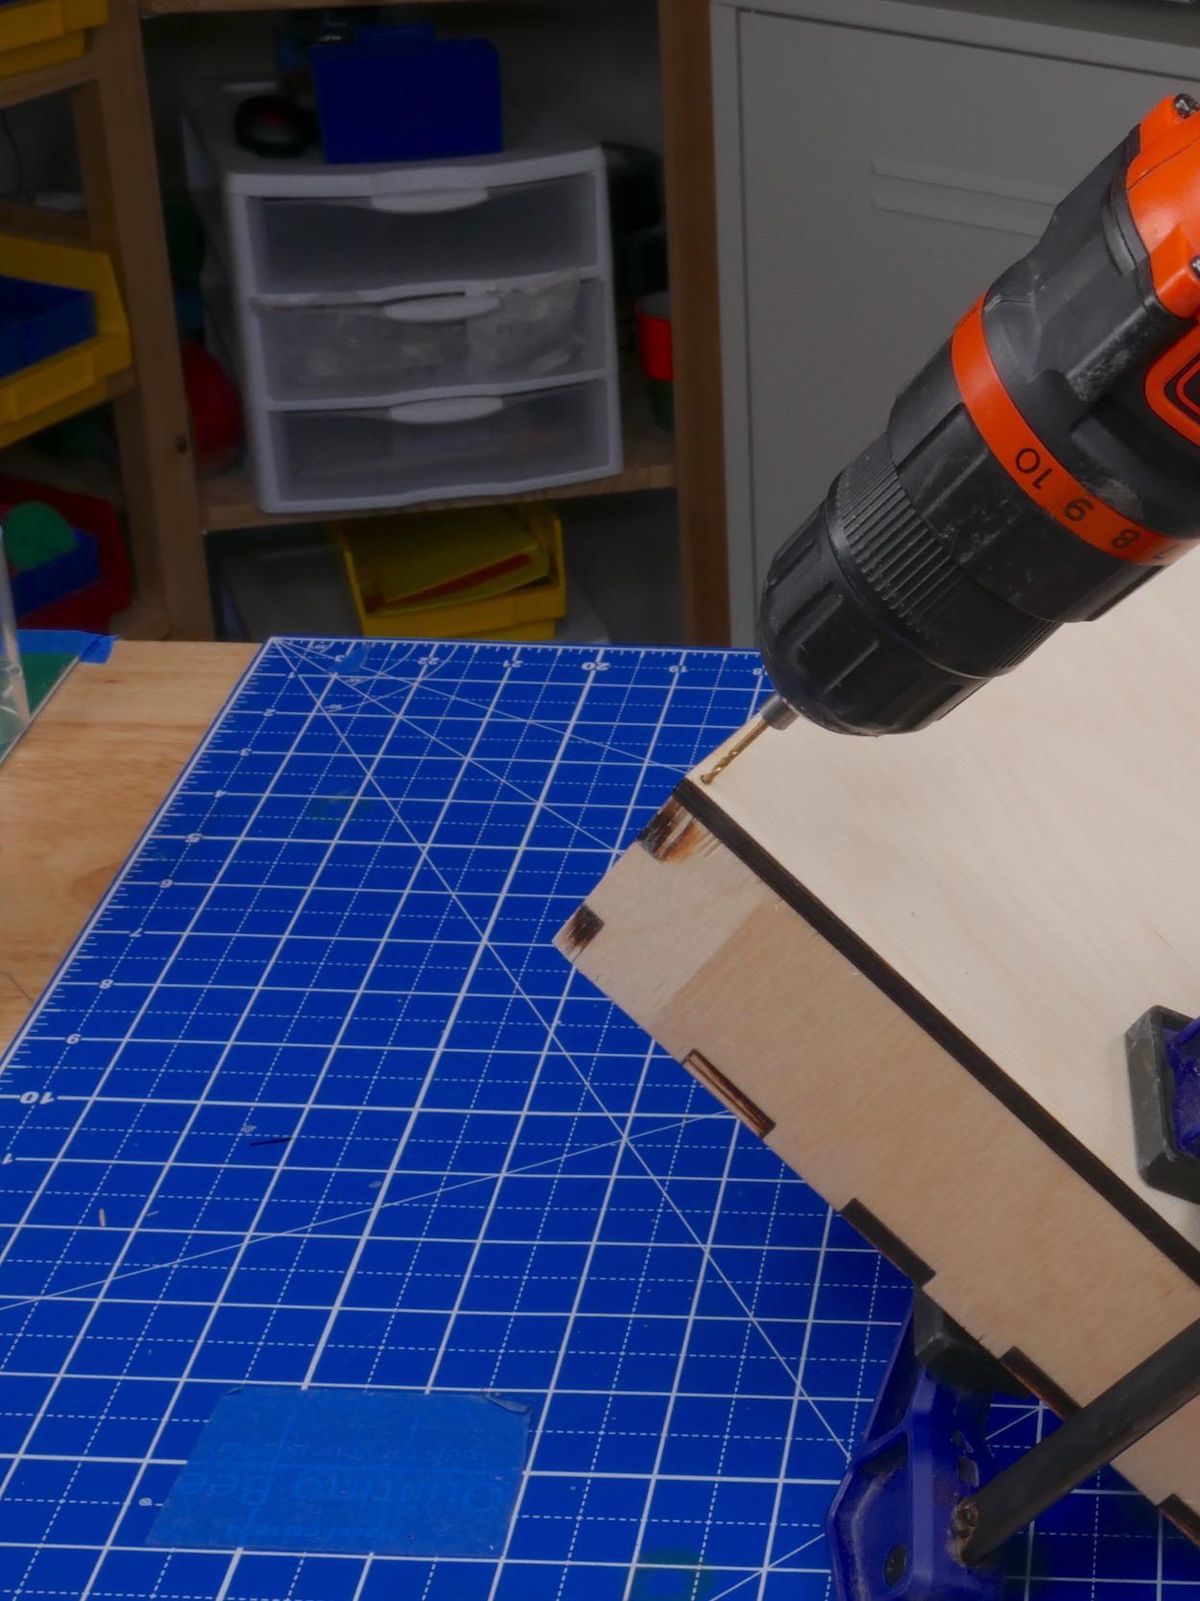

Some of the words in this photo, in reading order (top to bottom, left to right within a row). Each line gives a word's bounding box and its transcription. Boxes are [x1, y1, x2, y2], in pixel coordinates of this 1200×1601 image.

[1015, 447, 1053, 490] 10
[1111, 528, 1141, 549] 8
[417, 656, 440, 665] 22
[502, 659, 524, 668] 21
[581, 661, 610, 671] 20
[668, 664, 689, 673] 19
[99, 978, 114, 990] 8
[20, 1091, 55, 1105] 10
